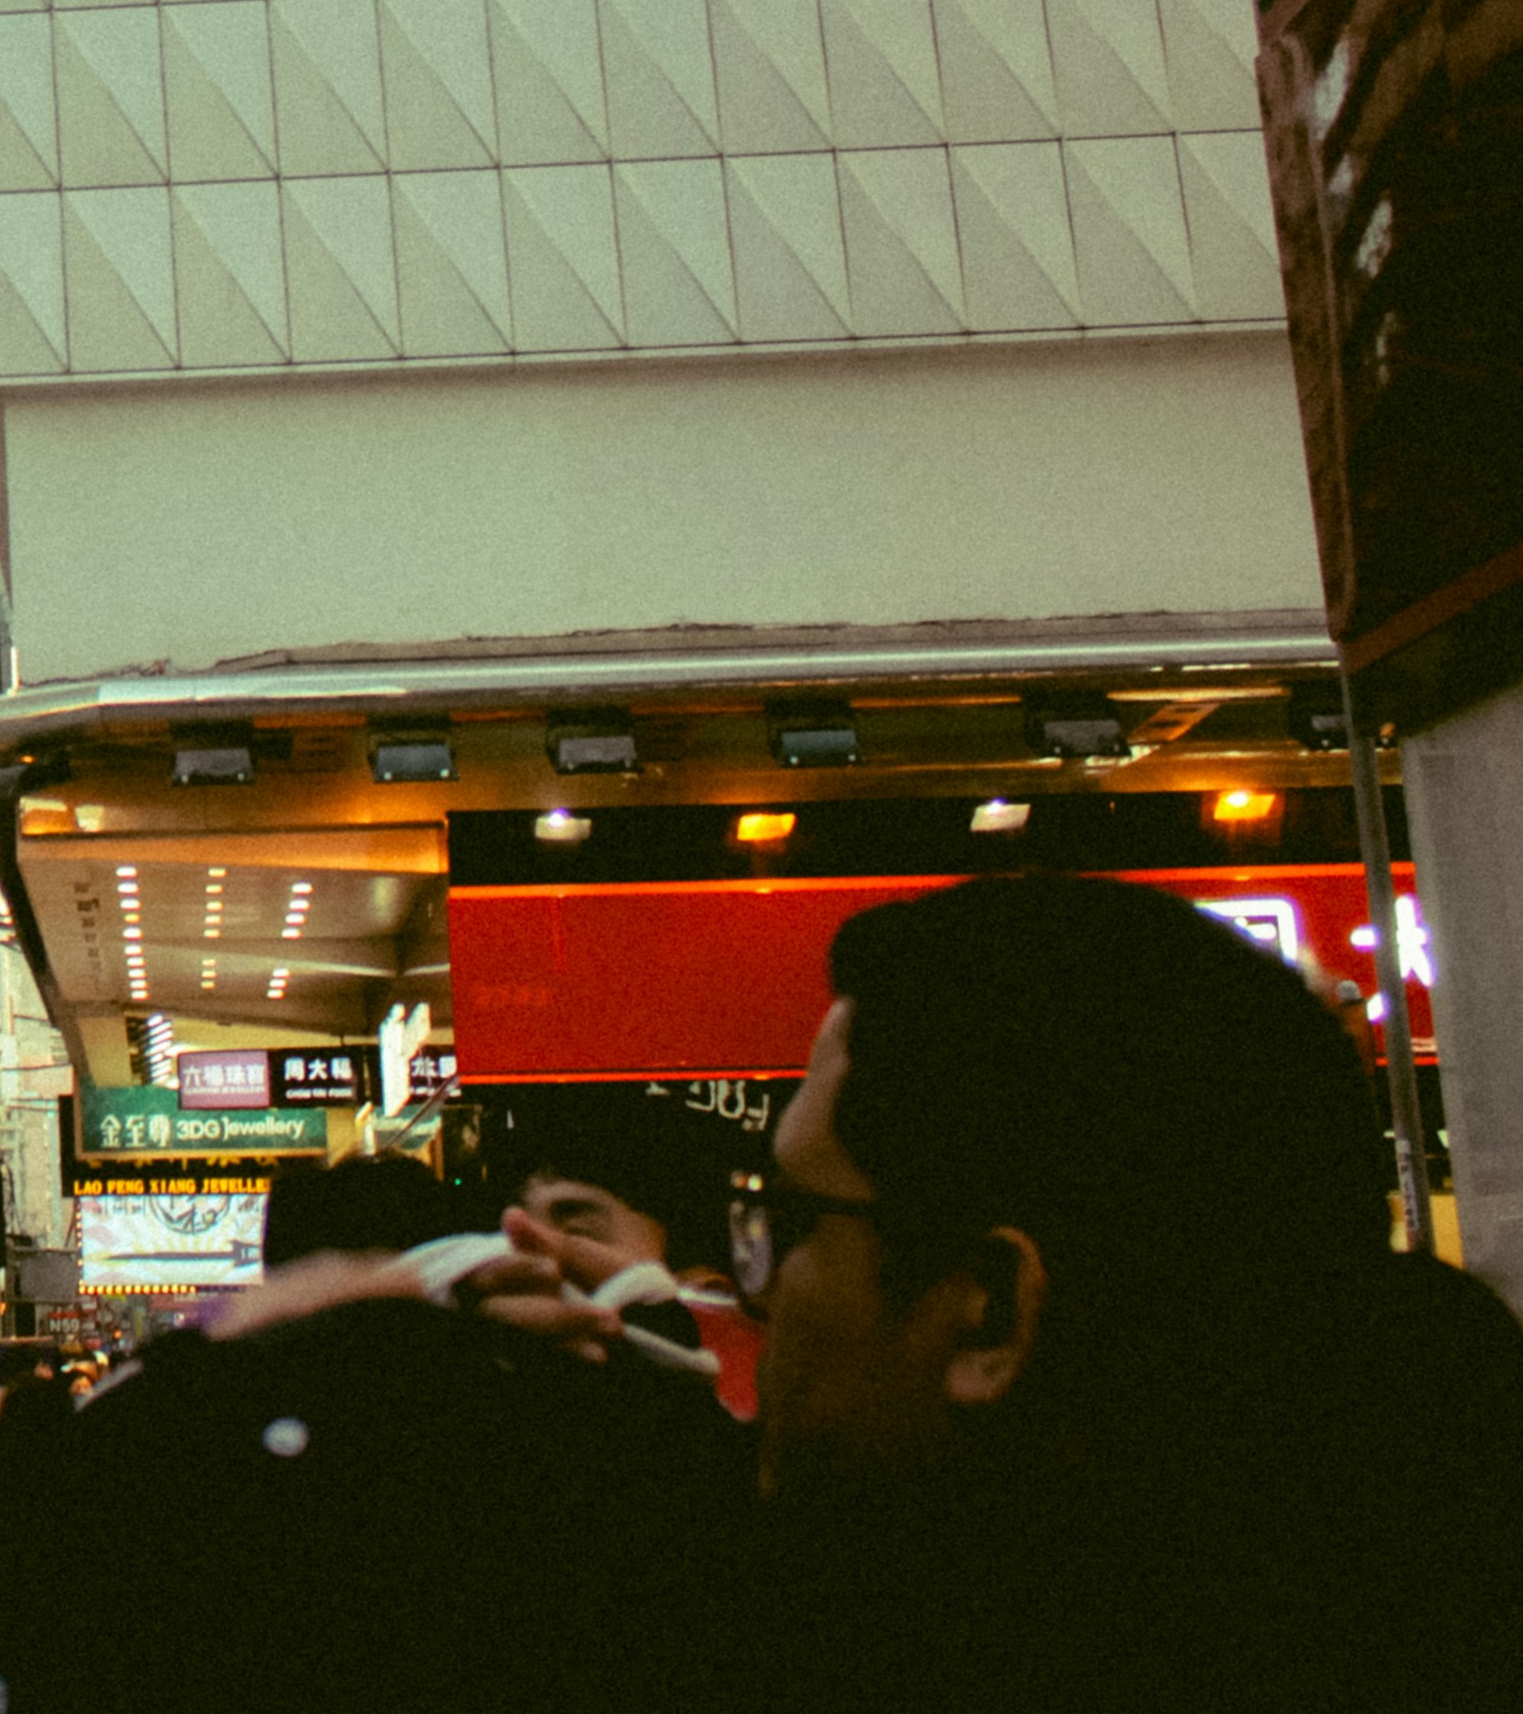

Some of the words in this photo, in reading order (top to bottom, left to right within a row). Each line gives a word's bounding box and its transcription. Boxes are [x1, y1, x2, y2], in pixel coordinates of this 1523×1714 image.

[283, 1056, 354, 1082] 周大福
[176, 1119, 220, 1140] 3DG
[222, 1115, 305, 1141] Jewellery
[74, 1179, 103, 1196] LAO
[149, 1177, 197, 1195] XIANG
